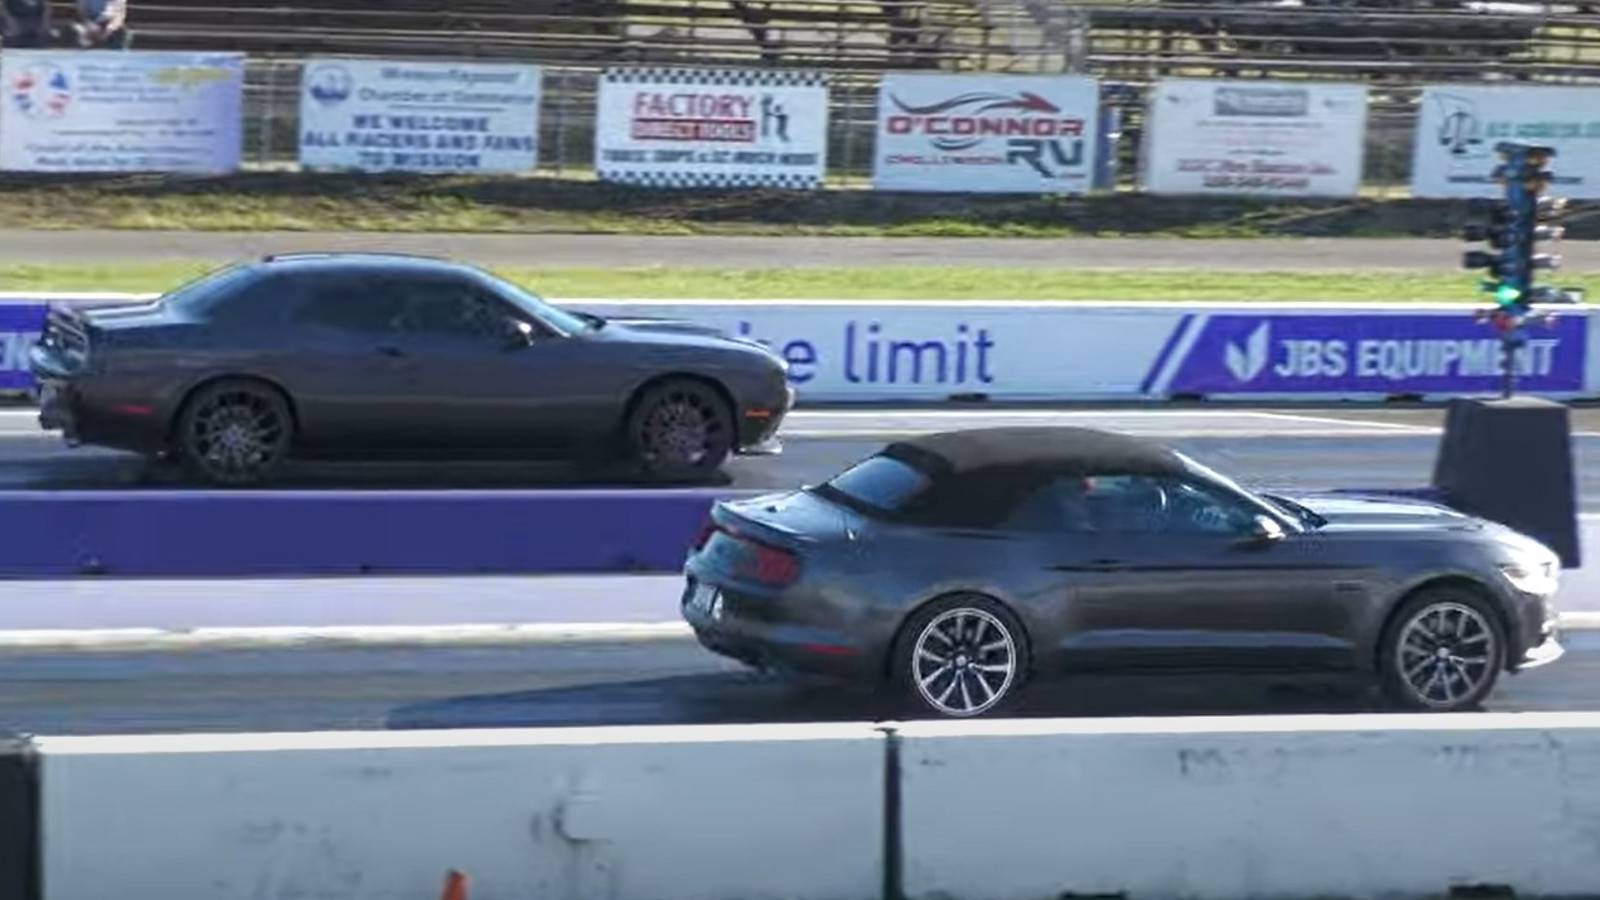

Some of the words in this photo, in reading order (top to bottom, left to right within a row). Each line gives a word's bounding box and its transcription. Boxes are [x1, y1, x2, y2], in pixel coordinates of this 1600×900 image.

[634, 92, 753, 118] FACTORY
[353, 115, 383, 130] WE
[389, 116, 490, 132] WELCOME
[887, 116, 1085, 137] O'CONNOR
[304, 131, 340, 147] ALL
[347, 132, 431, 149] RACERS
[435, 134, 477, 151] AND
[484, 136, 532, 152] FANS
[358, 151, 385, 165] TO
[394, 153, 480, 168] MISSION
[1007, 138, 1085, 179] RV
[844, 322, 994, 384] limit
[1275, 340, 1348, 376] JBS
